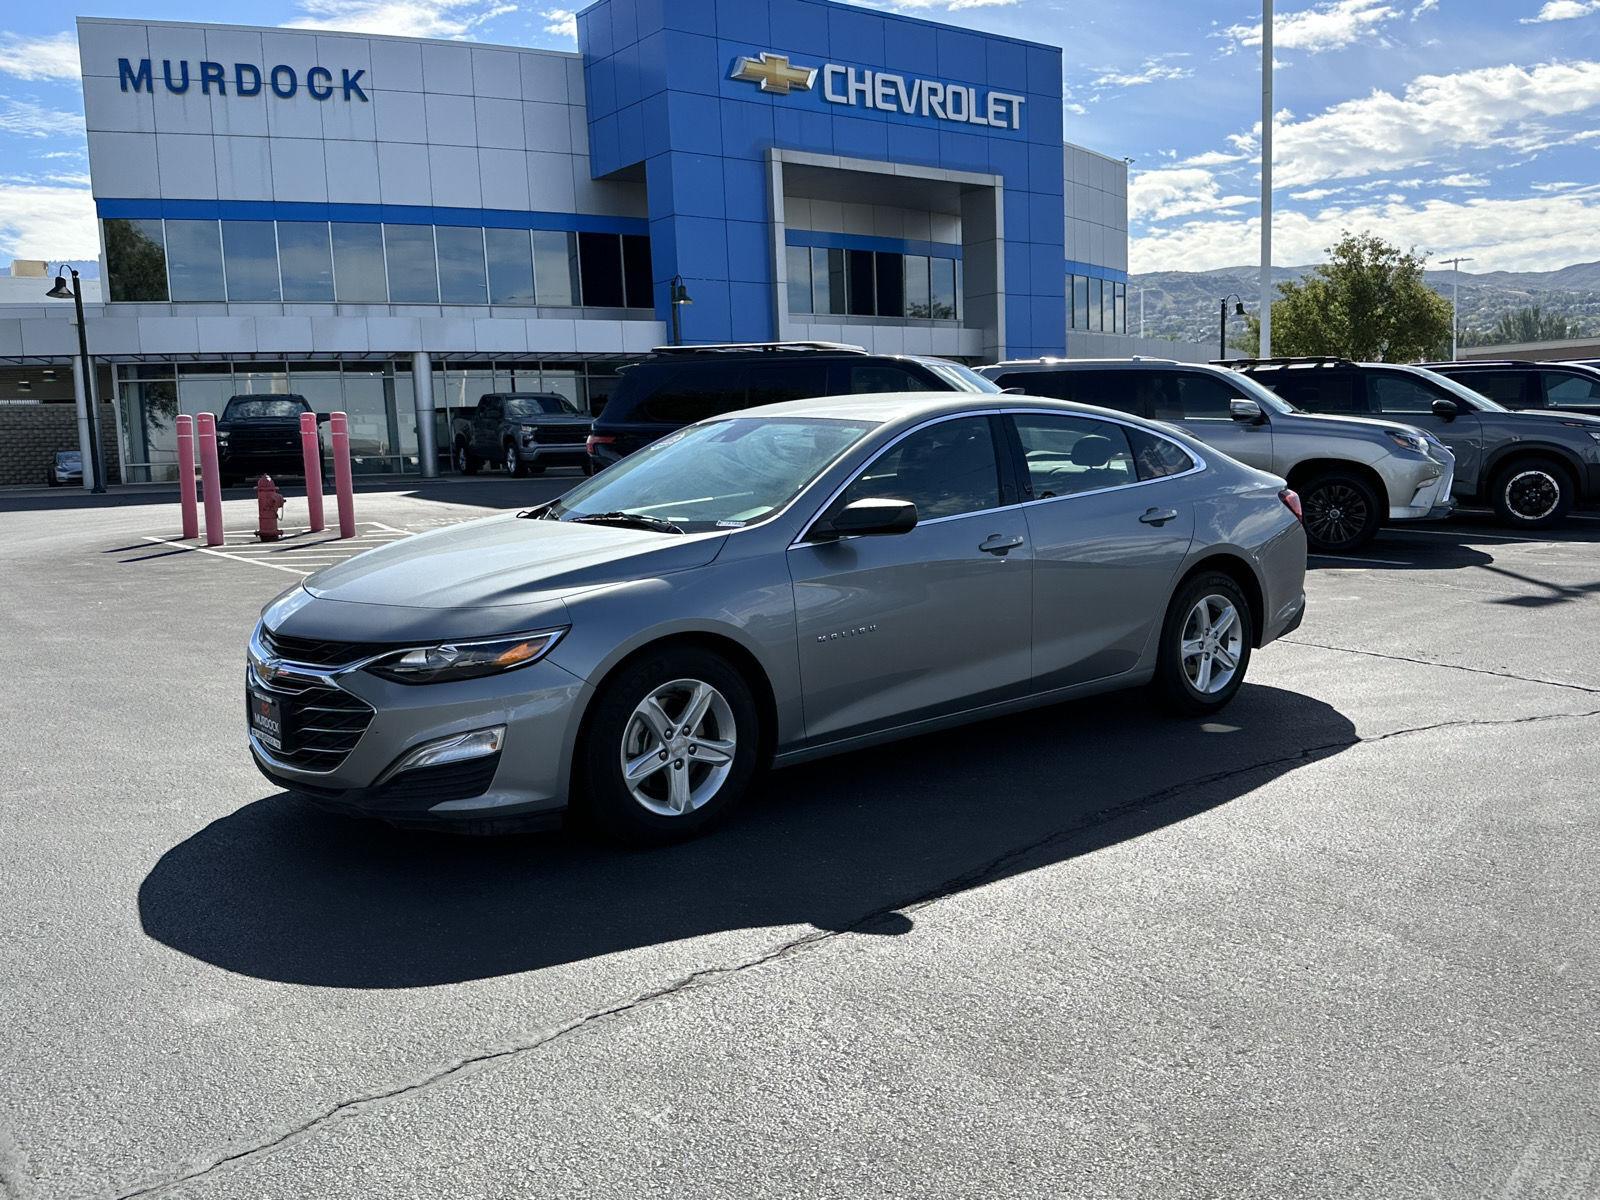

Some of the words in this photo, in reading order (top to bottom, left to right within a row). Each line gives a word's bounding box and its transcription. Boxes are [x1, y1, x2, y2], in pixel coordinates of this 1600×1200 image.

[118, 57, 369, 102] MURDOCK
[824, 63, 1025, 130] CHEVROLET
[817, 624, 877, 643] MALIBU
